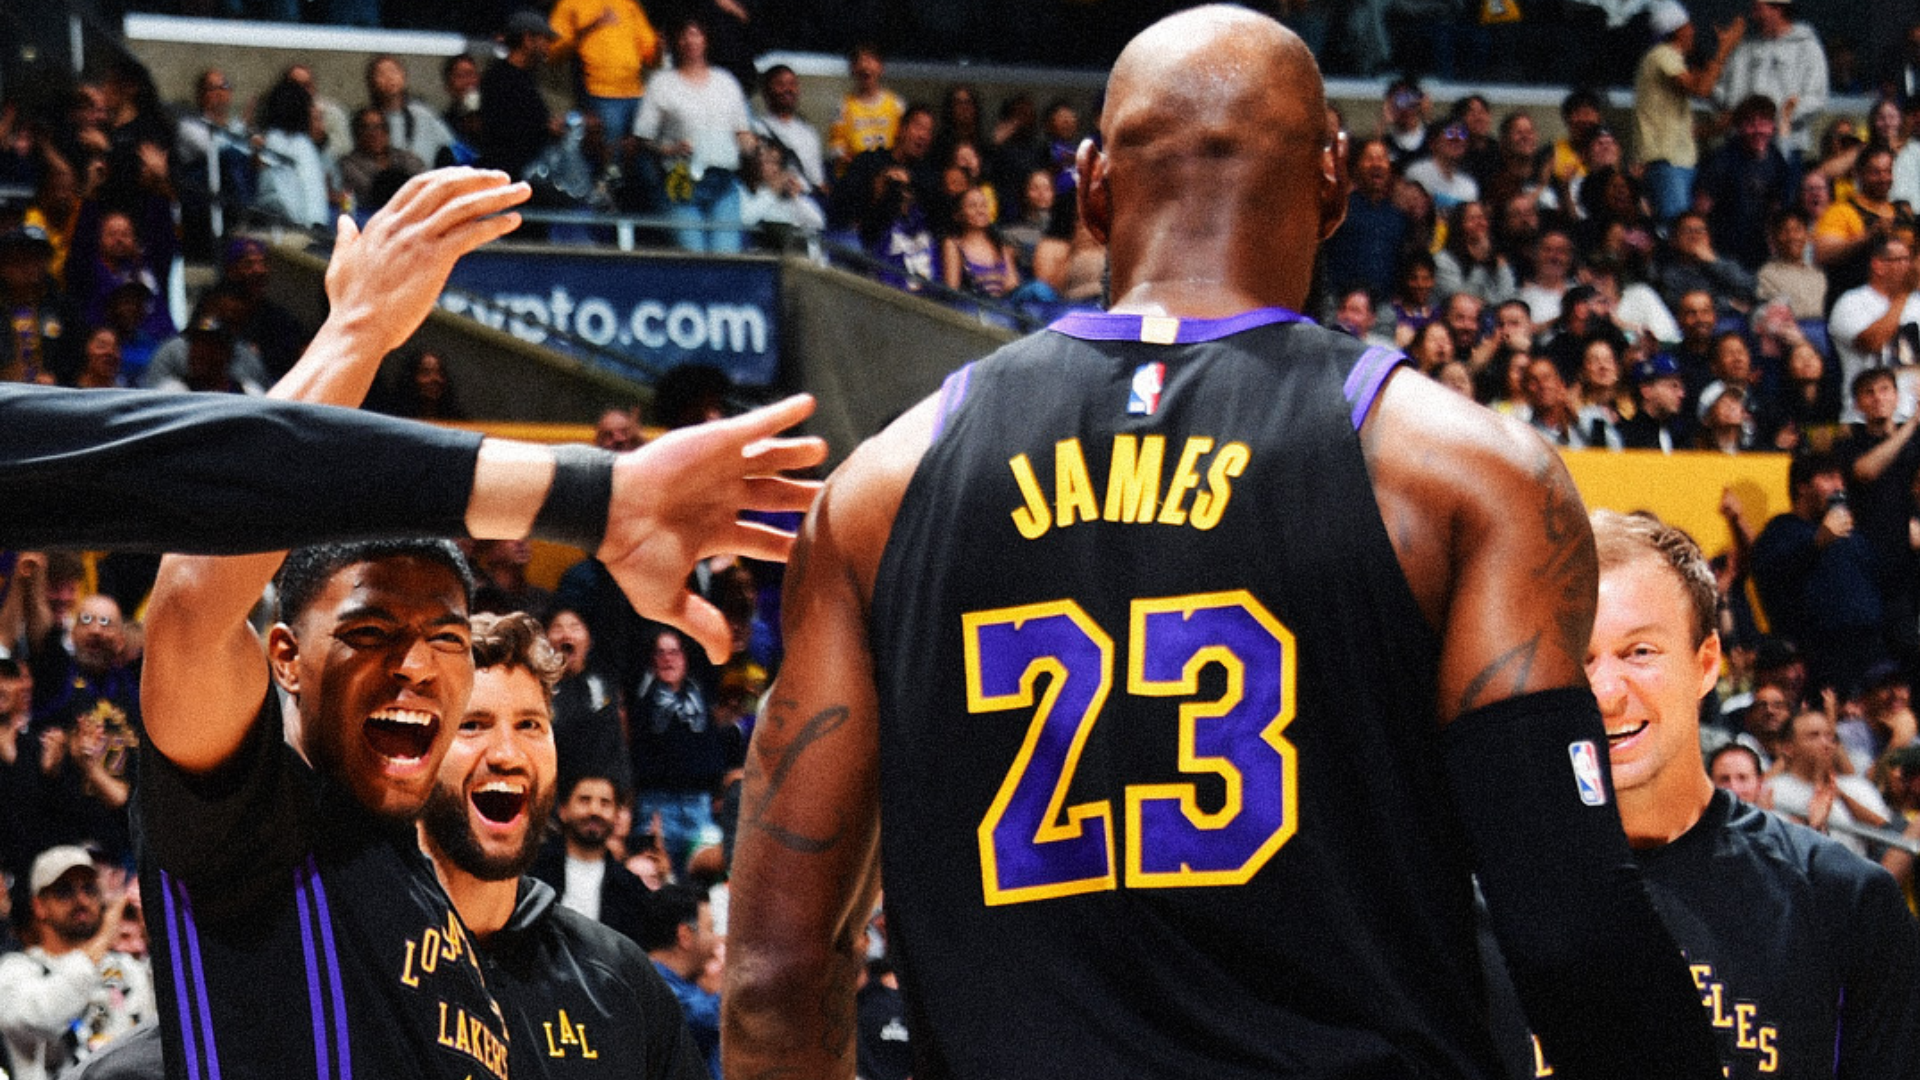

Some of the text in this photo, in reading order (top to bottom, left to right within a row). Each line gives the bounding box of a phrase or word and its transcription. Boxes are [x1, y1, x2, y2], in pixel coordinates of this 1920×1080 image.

[1008, 432, 1252, 541] JAMES
[960, 588, 1299, 908] 23
[542, 1008, 599, 1060] LAL
[1682, 951, 1779, 1073] ELES
